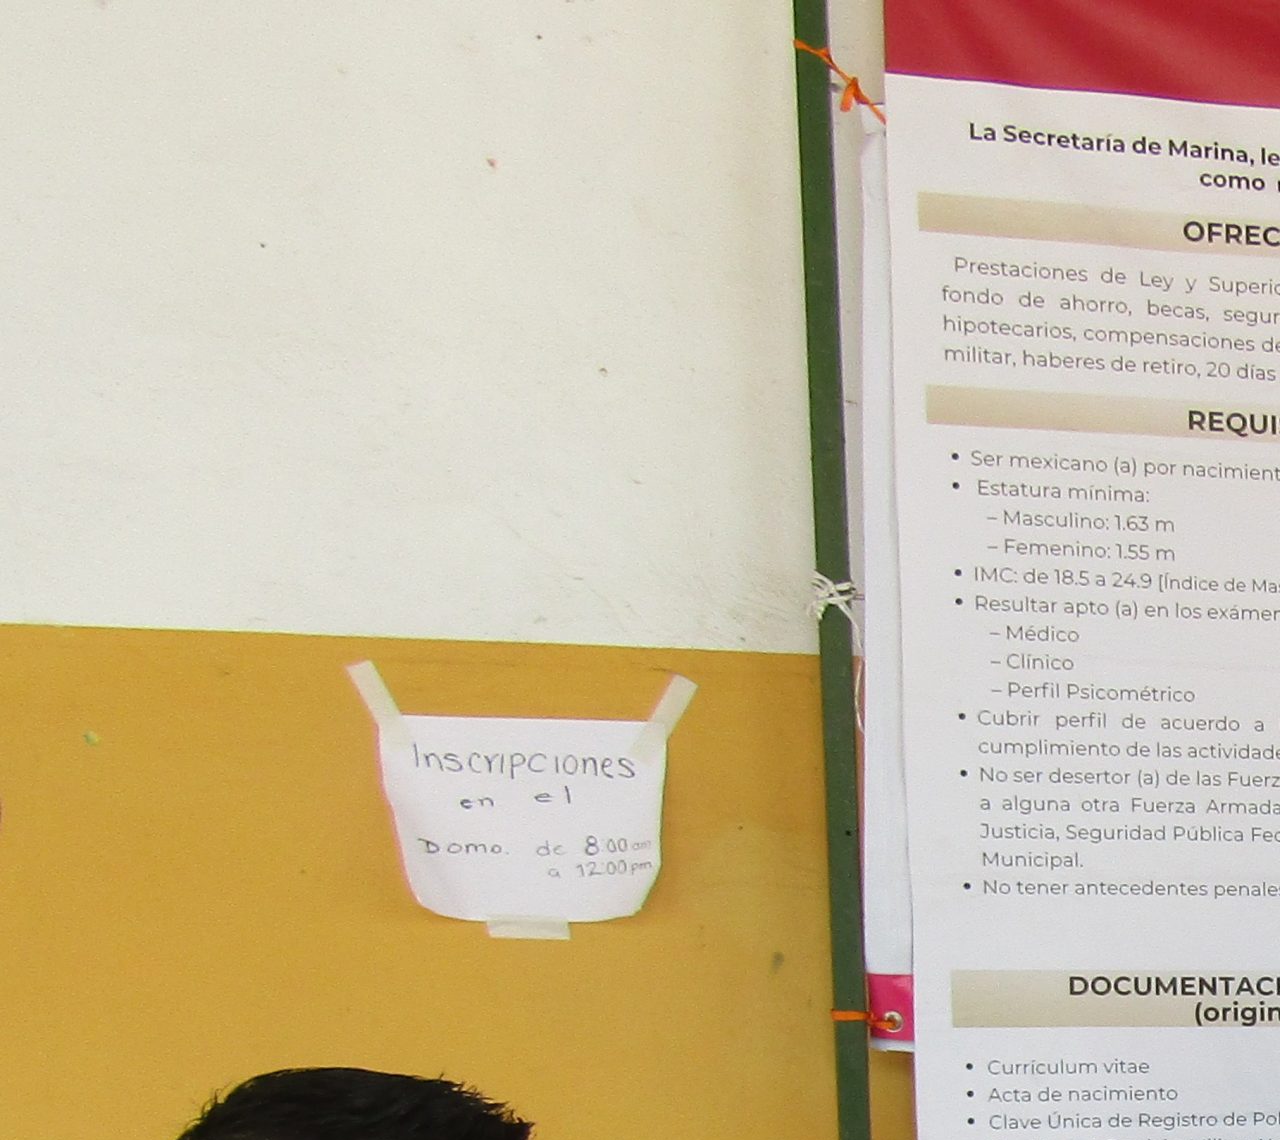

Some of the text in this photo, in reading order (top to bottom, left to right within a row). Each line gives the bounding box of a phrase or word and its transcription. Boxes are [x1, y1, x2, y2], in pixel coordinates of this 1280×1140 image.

[970, 122, 996, 141] La
[1003, 125, 1125, 153] Secretaría
[1132, 136, 1162, 155] de
[1169, 139, 1255, 167] Marina,
[1261, 147, 1280, 166] le
[1199, 173, 1265, 191] como
[413, 742, 635, 779] Inscripciones
[460, 785, 571, 809] en el
[548, 868, 560, 878] a
[983, 879, 1011, 895] No
[1016, 881, 1070, 895] tener
[1074, 880, 1208, 896] antecedentes
[987, 1058, 1150, 1075] Currículum vitae
[988, 1085, 1178, 1103] Acta de nacimiento
